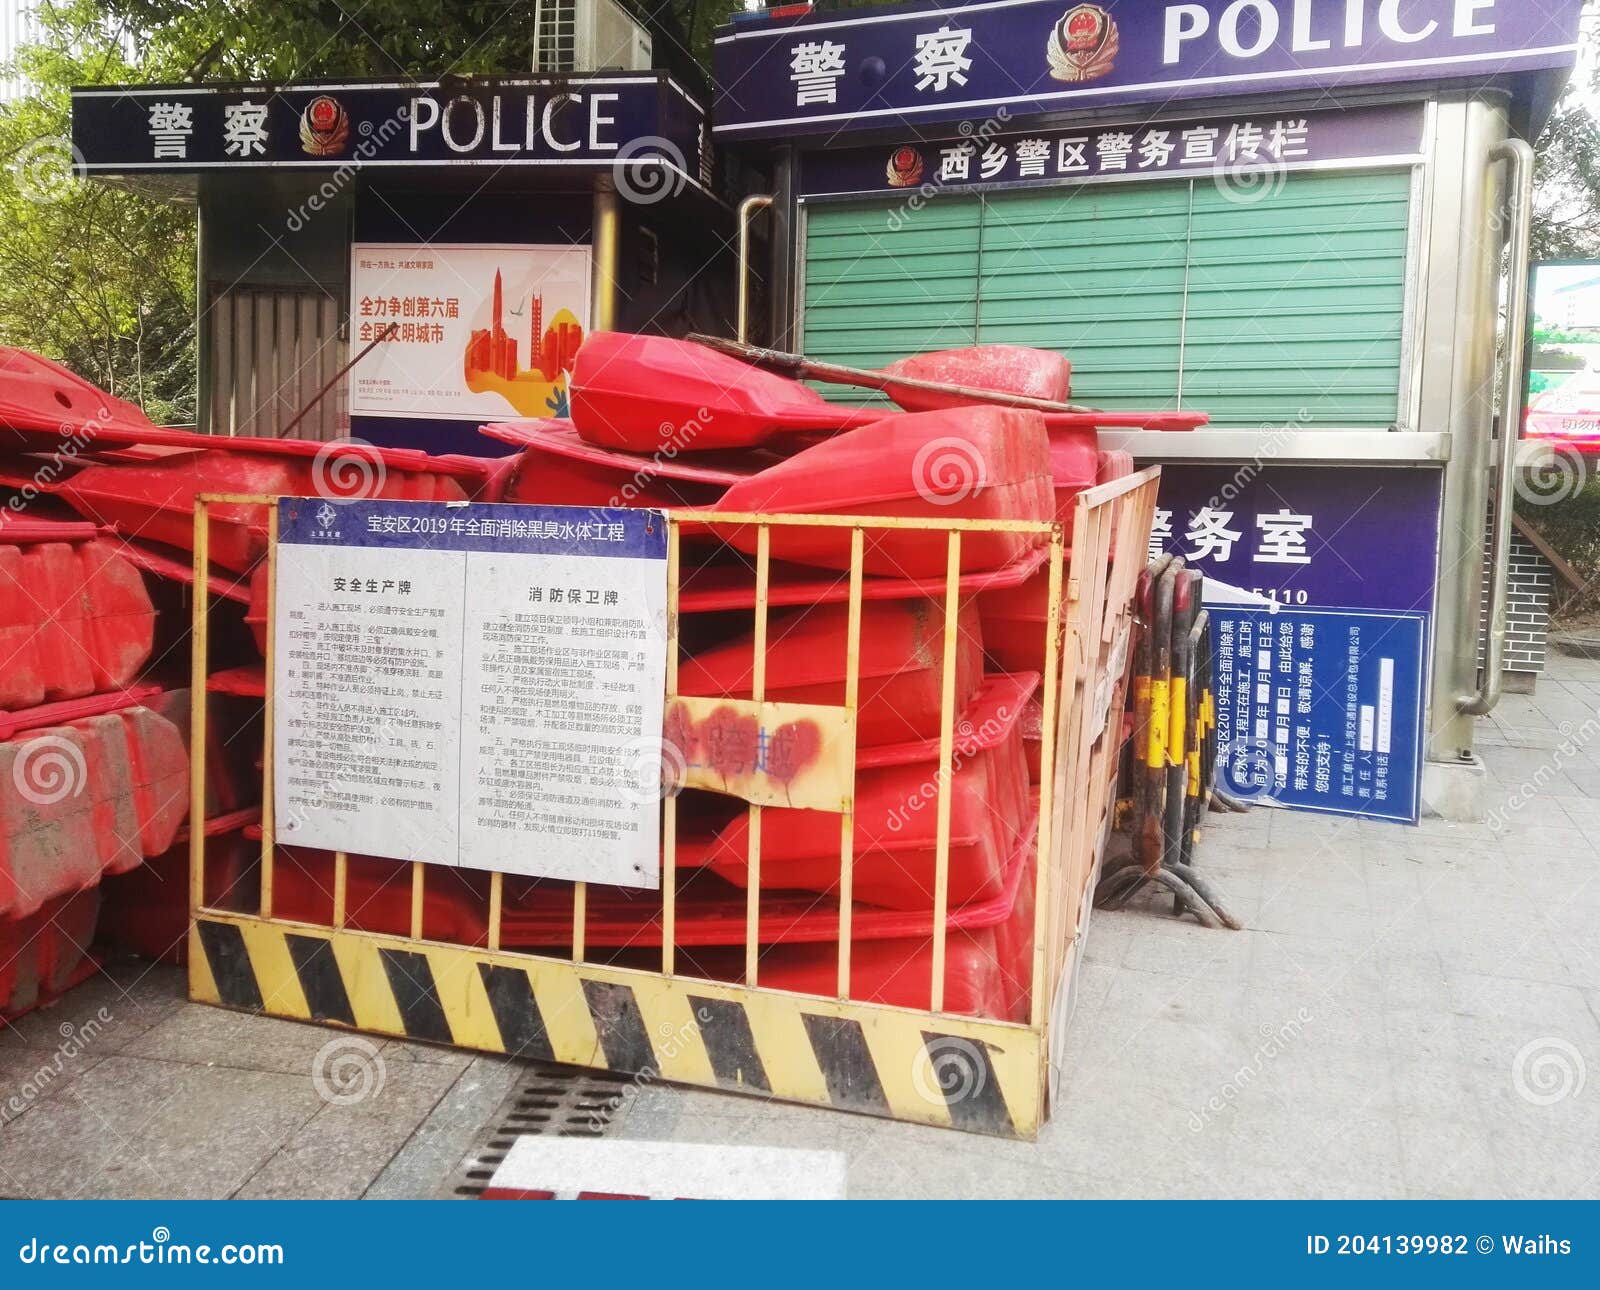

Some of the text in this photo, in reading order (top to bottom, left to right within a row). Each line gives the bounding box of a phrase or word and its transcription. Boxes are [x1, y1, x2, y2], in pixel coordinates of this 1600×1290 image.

[1163, 0, 1497, 64] POLICE
[789, 26, 974, 106] 警察
[148, 101, 270, 158] 警察
[408, 93, 620, 153] POLICE
[939, 118, 1309, 181] 西乡警区警务宣传栏
[360, 296, 459, 318] 全力争创第六届
[360, 321, 444, 343] 全国文明城市
[1560, 416, 1600, 431] 切勿
[367, 515, 625, 543] 宝安区2019年全面消除黑臭水体工程
[334, 577, 412, 596] 安全生产牌
[529, 586, 619, 606] 消防保卫牌
[1216, 620, 1234, 768] 宝安区2019年全面消除黑
